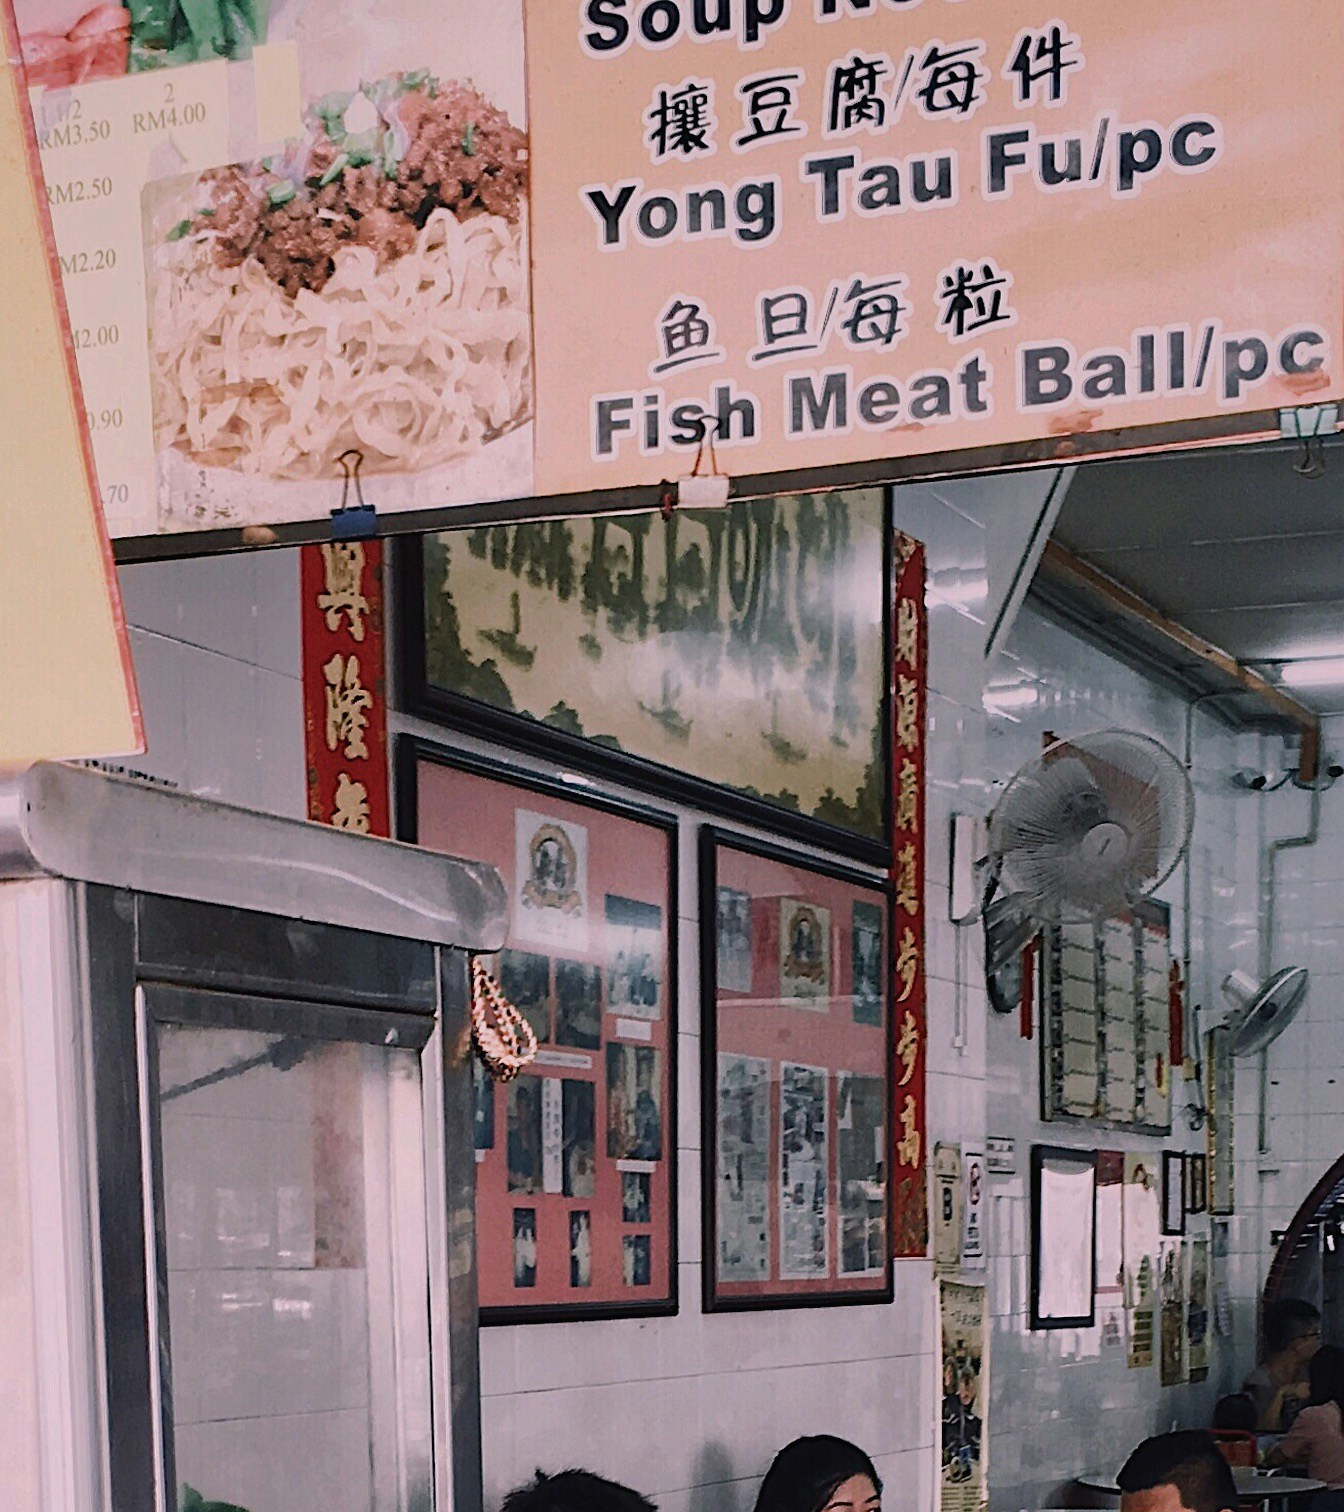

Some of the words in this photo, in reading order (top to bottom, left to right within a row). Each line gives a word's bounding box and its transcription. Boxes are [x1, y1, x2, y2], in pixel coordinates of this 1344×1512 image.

[585, 0, 783, 51] Soup
[39, 119, 111, 150] RM3.50
[132, 102, 206, 133] RM4.00
[586, 180, 777, 246] Yong
[805, 154, 954, 217] Tau
[986, 113, 1218, 194] Fu/pc
[59, 248, 116, 275] M2.20
[653, 264, 1010, 374] 鱼旦/每粒
[595, 385, 755, 455] Fish
[789, 354, 987, 433] Meat
[1021, 324, 1325, 406] Ball/pc
